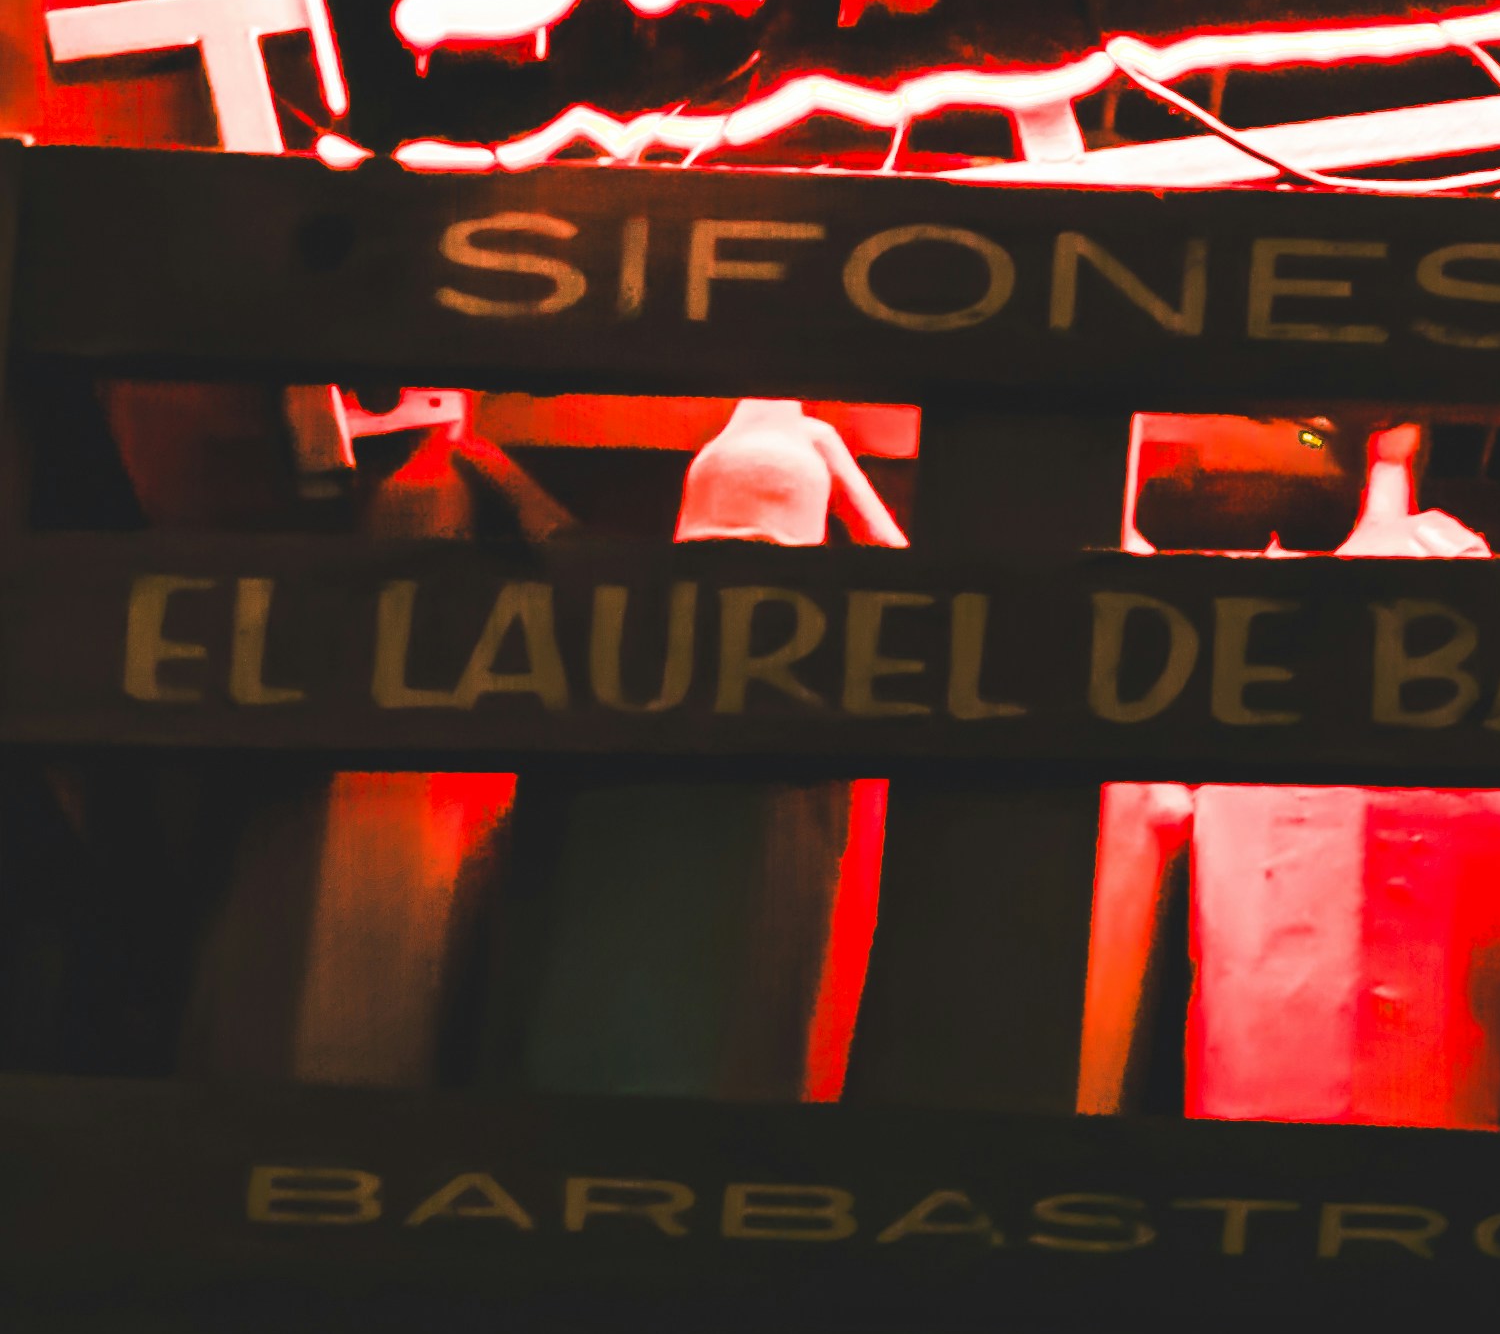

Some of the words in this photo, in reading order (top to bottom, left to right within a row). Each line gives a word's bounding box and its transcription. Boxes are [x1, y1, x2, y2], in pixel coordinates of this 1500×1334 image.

[122, 575, 308, 709] EL
[373, 579, 1029, 725] LAUREL
[1088, 591, 1305, 728] DE
